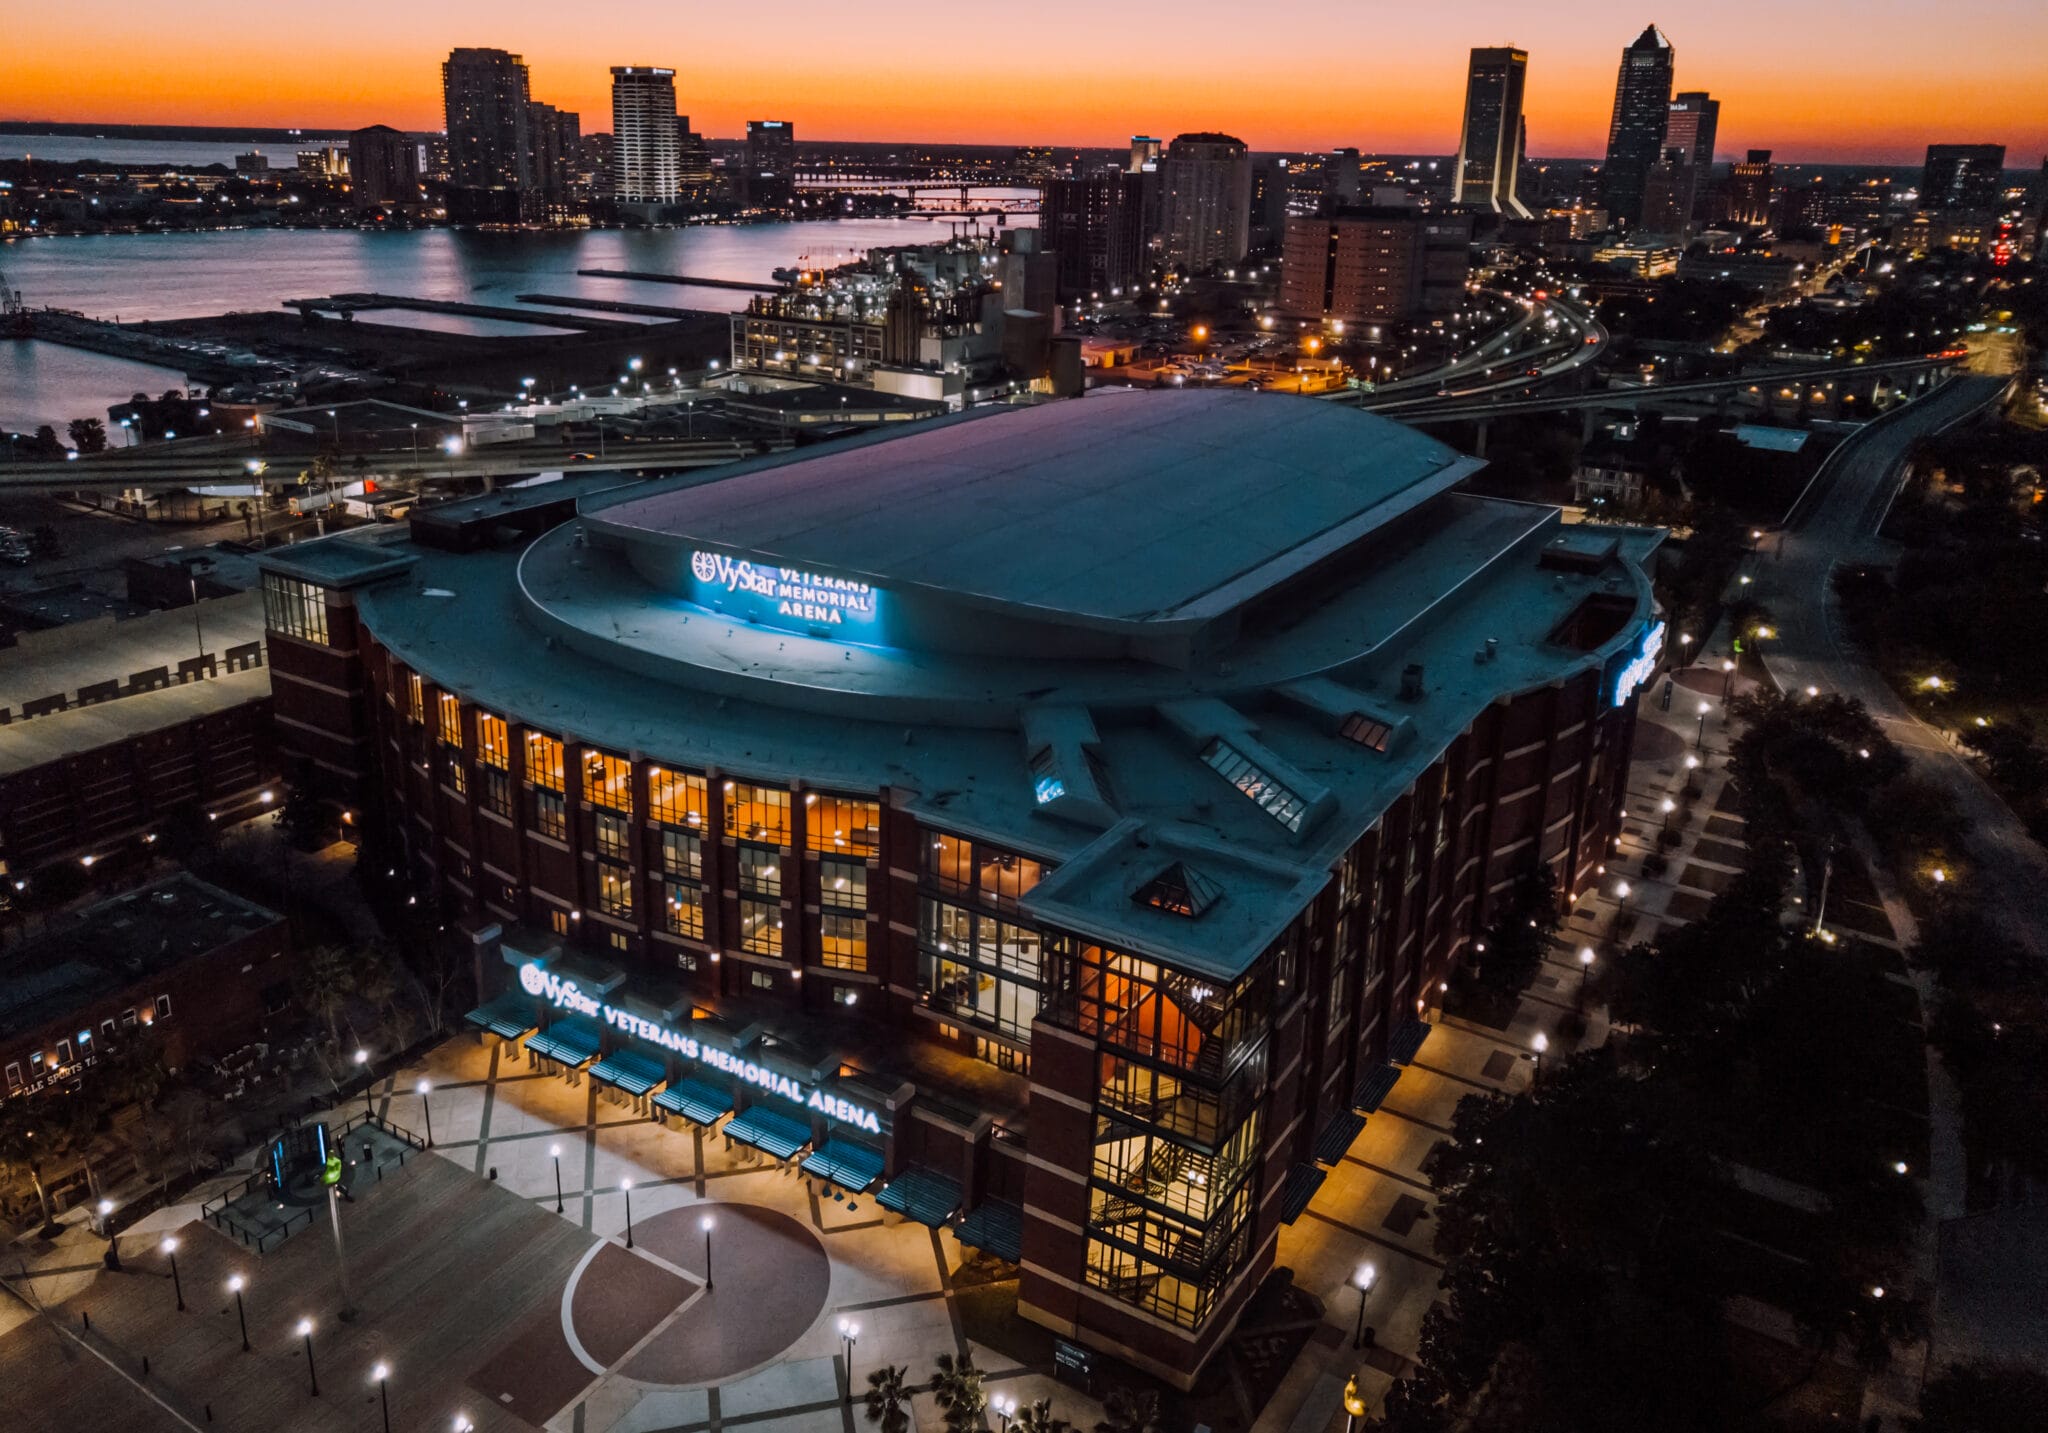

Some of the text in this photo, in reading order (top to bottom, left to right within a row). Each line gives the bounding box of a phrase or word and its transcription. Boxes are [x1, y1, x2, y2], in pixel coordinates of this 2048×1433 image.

[713, 554, 777, 597] VyStar
[779, 584, 869, 611] MEMORIAL
[779, 600, 842, 624] ARENA
[540, 970, 882, 1134] VyStar VETERANS MEMORIAL ARENA
